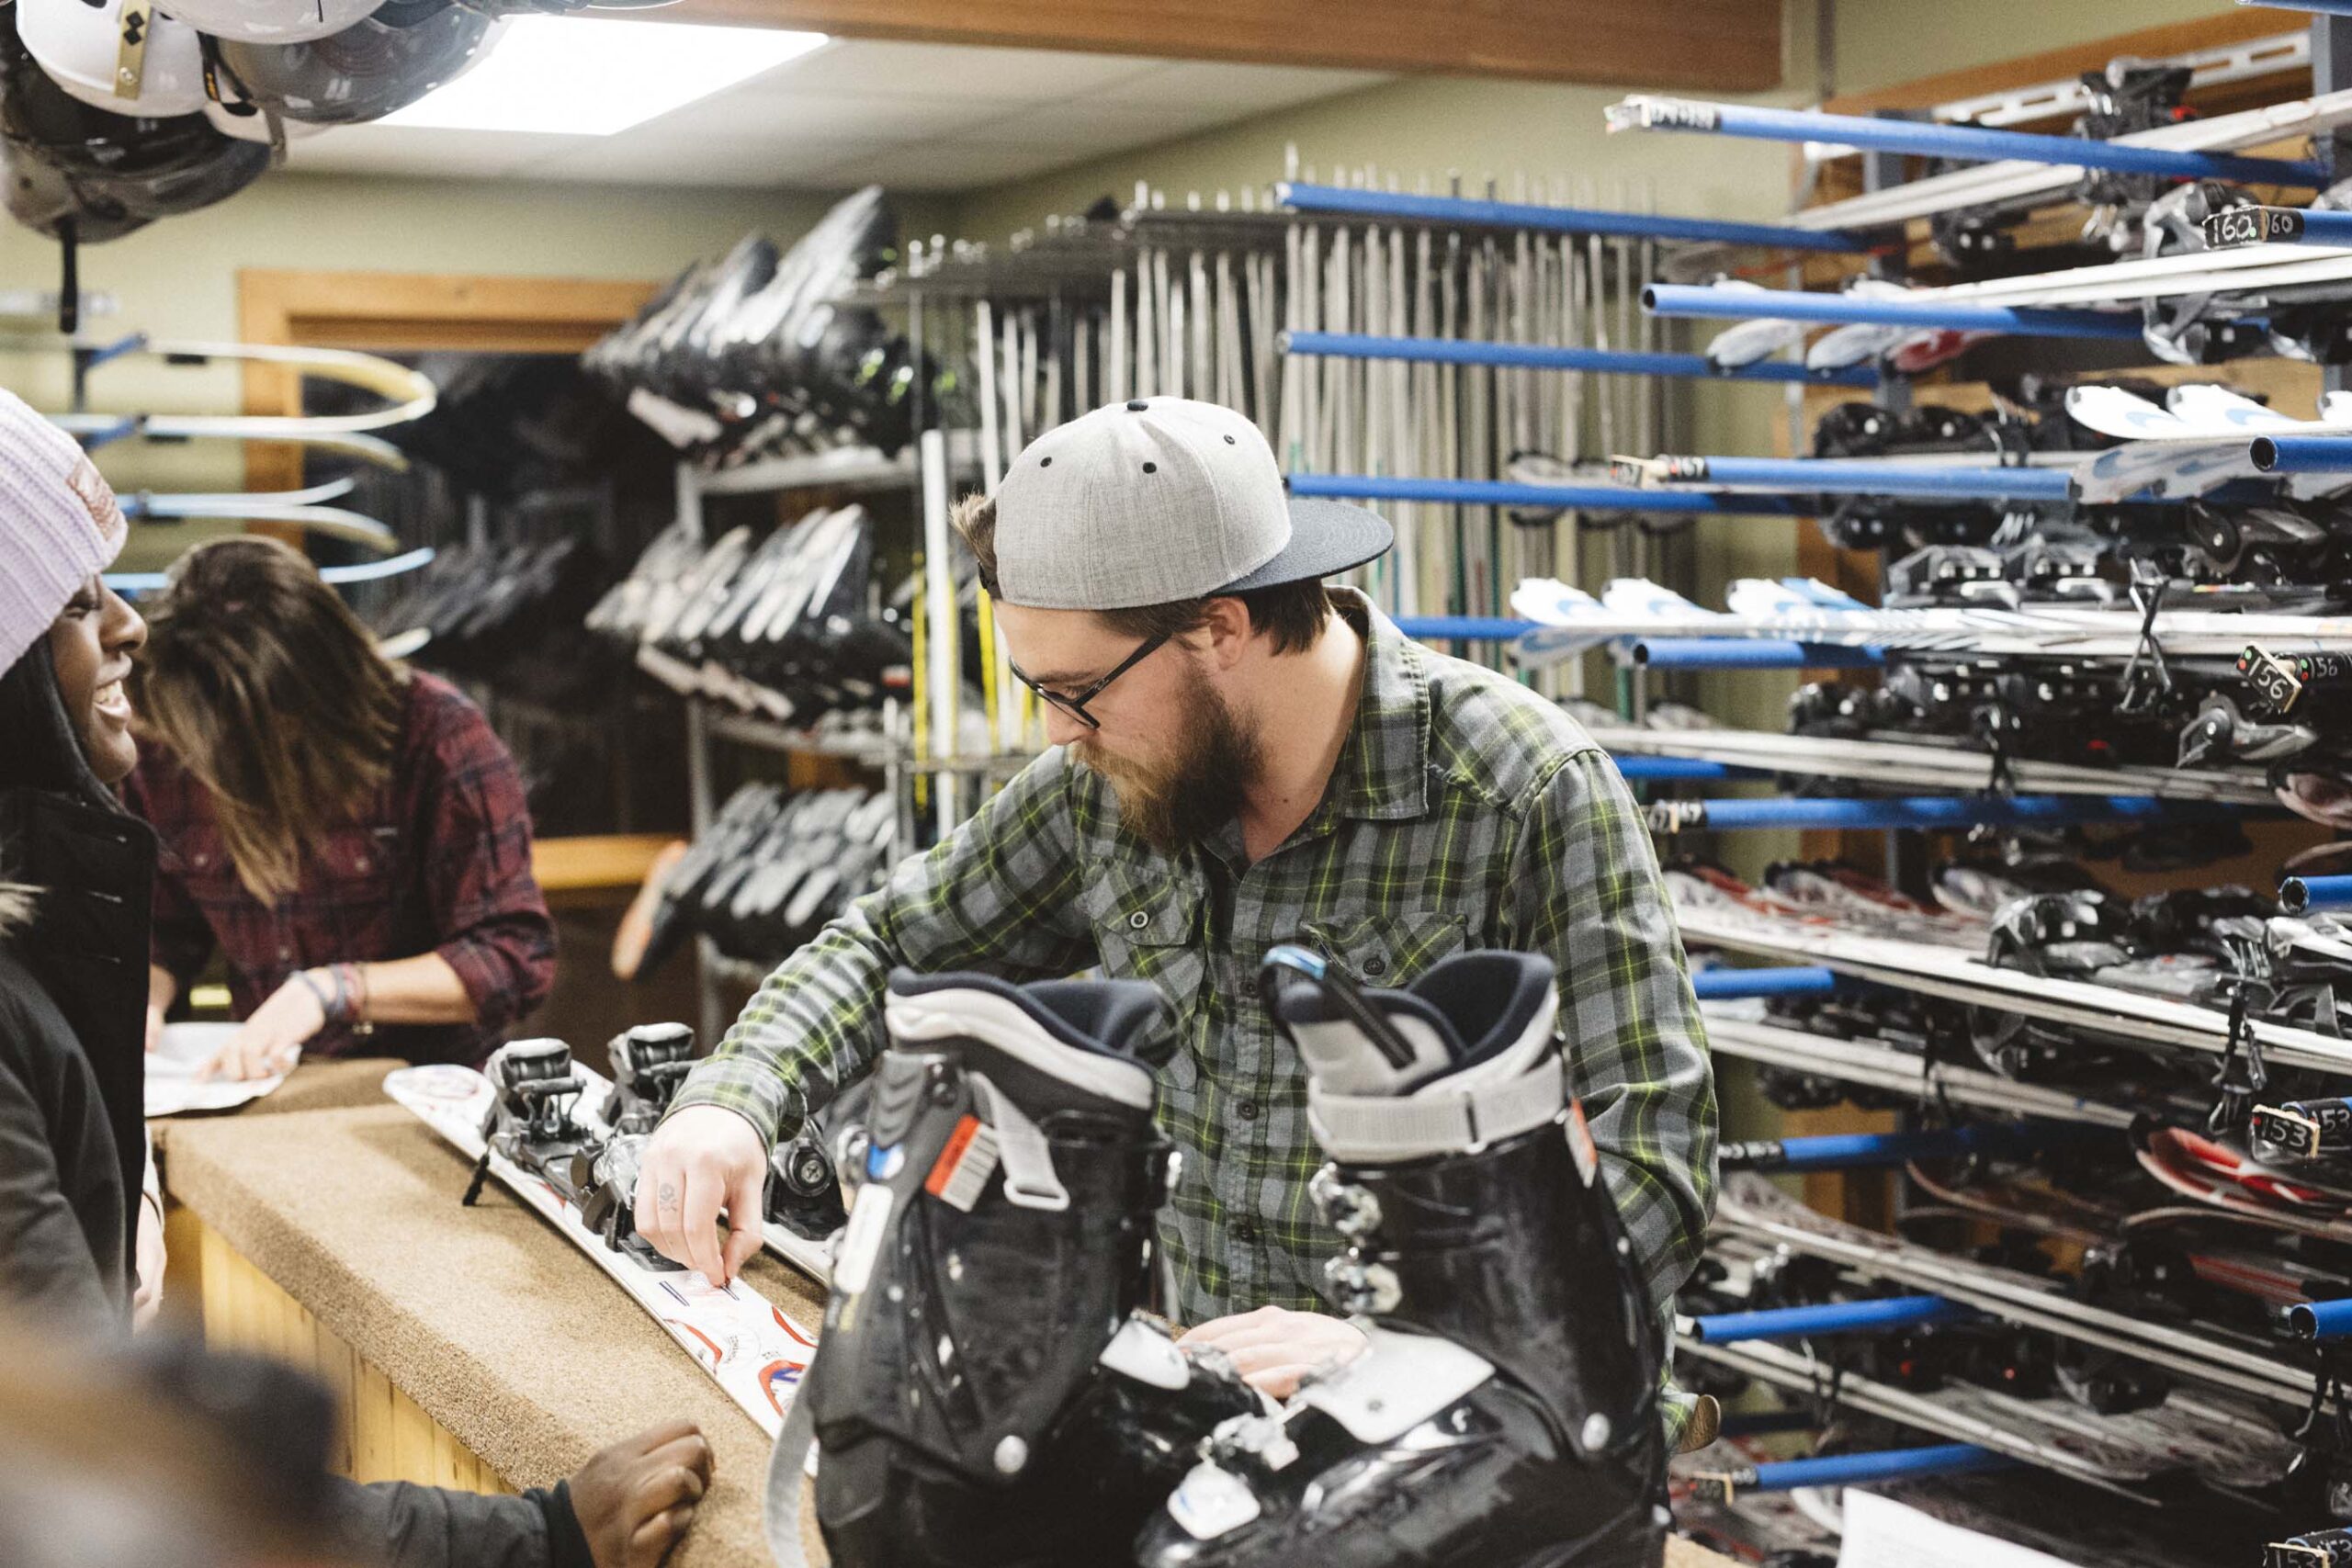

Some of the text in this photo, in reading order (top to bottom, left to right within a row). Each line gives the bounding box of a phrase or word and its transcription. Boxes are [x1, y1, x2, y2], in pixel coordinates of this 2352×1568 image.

[2213, 214, 2253, 243] 160
[2248, 656, 2288, 699] 156
[2307, 656, 2338, 678] 156
[2262, 1114, 2308, 1147] 153
